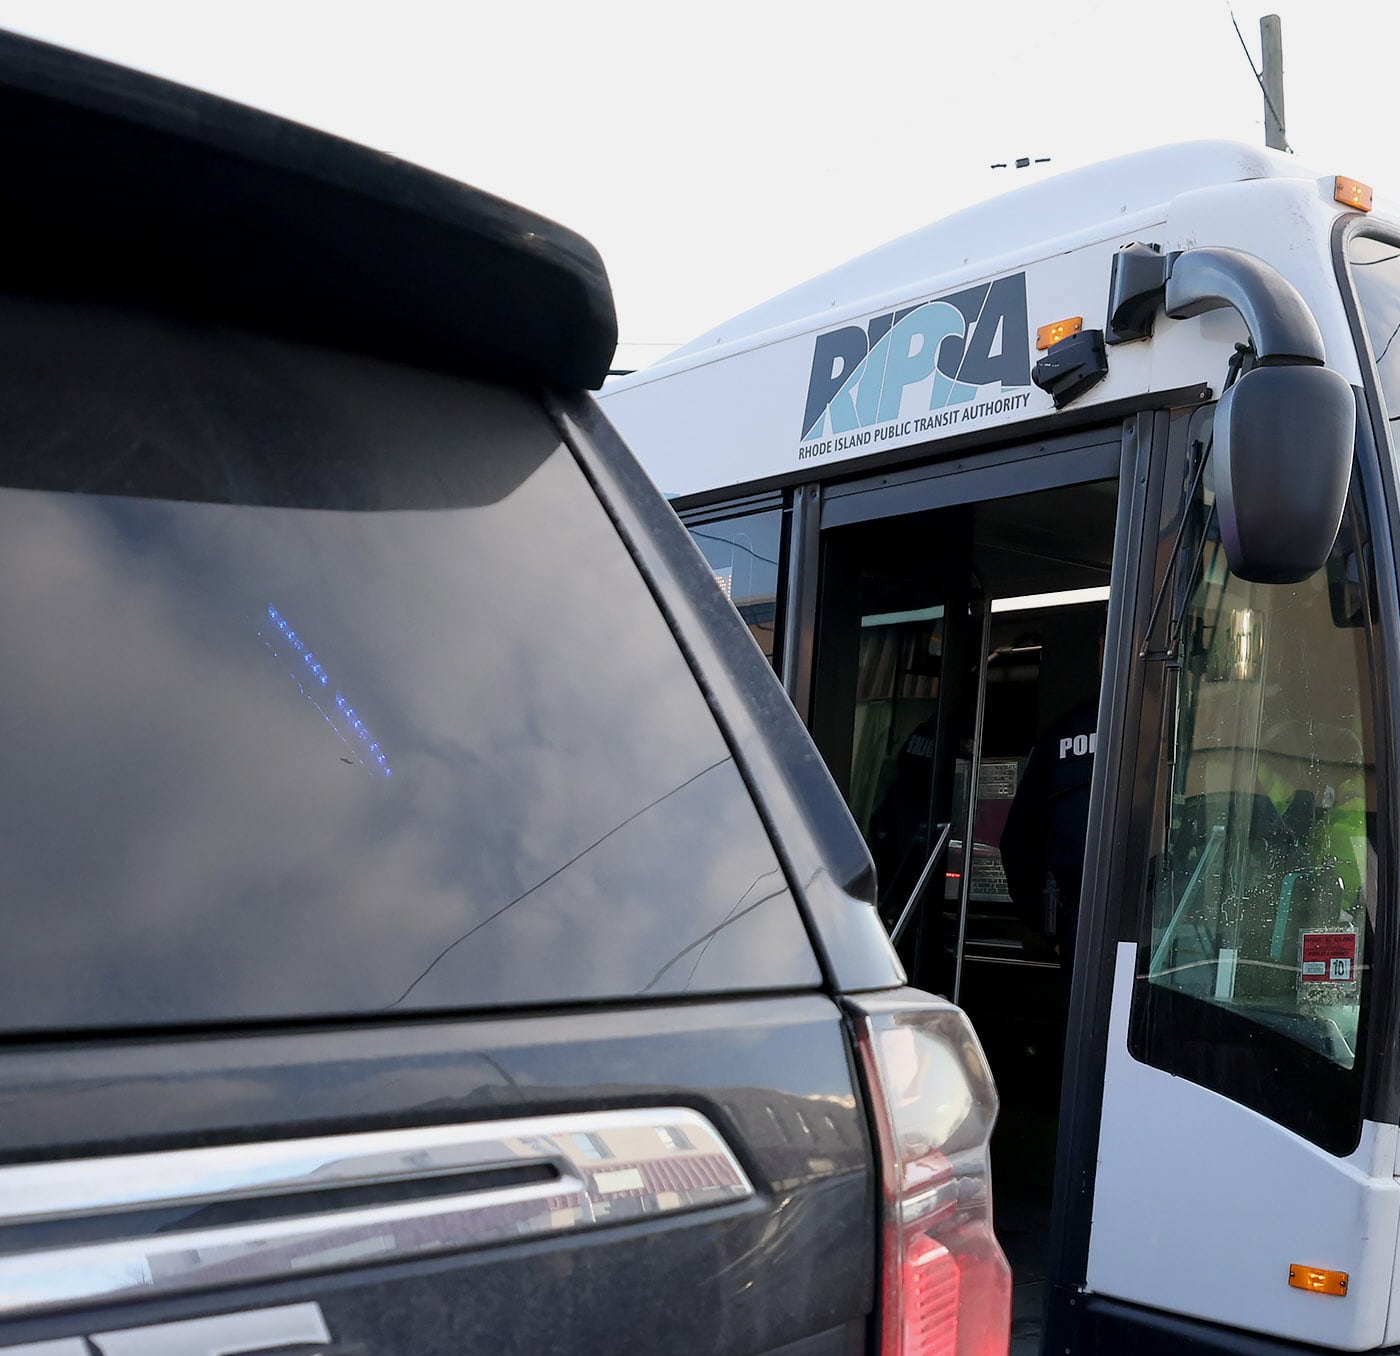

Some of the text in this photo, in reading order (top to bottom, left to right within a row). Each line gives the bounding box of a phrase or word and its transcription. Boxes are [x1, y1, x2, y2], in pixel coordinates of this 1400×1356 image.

[799, 392, 1031, 460] RHODE ISLAND PUBLIC TRANSIT AUTHORITY
[1332, 959, 1345, 976] 10
